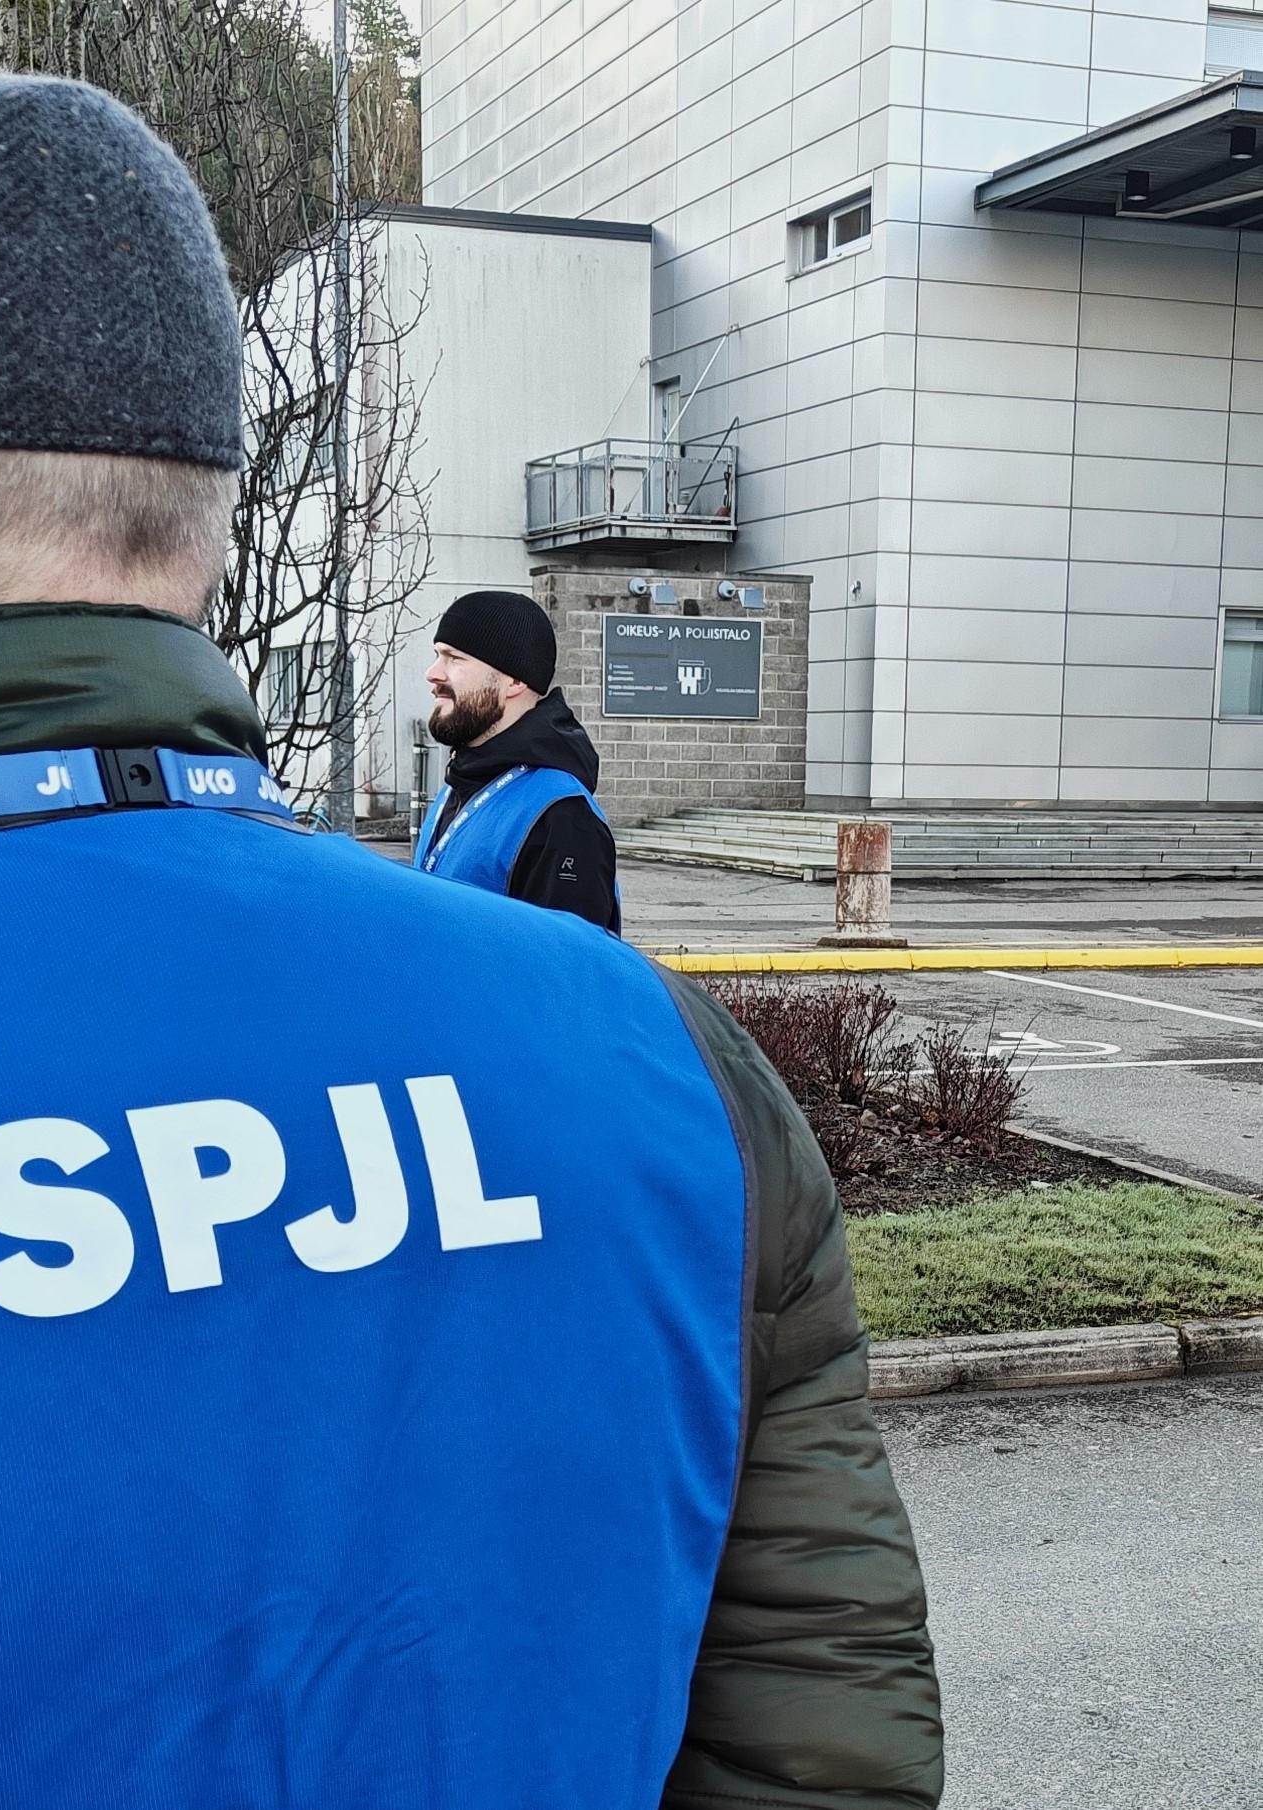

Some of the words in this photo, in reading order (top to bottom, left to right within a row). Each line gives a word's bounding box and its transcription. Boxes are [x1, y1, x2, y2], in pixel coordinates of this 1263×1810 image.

[616, 624, 664, 638] OIKEUS-
[668, 626, 681, 641] JA
[685, 627, 751, 641] POLIISITALO
[561, 856, 574, 870] R
